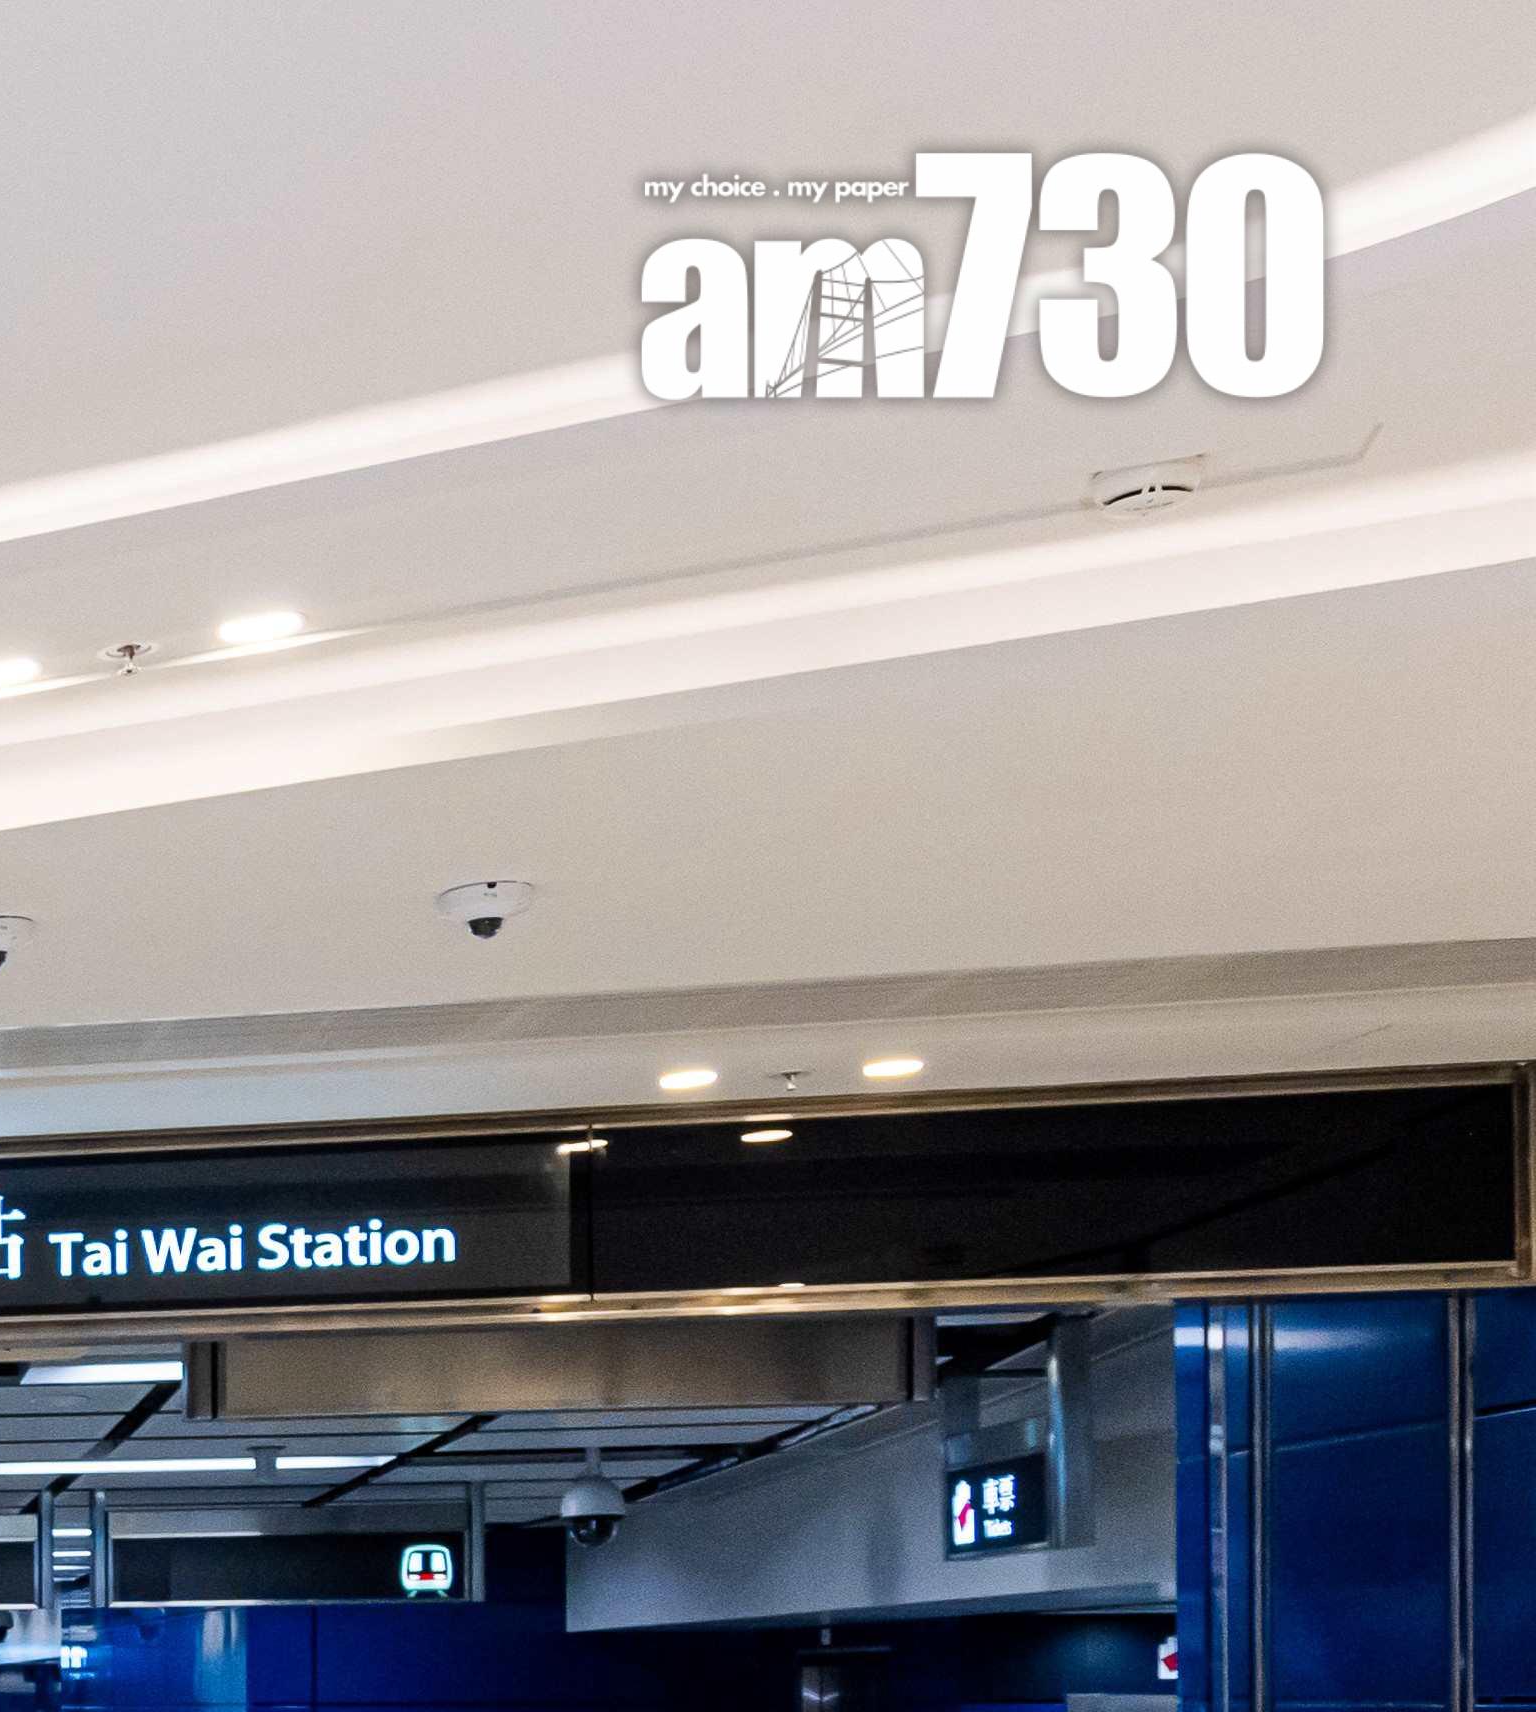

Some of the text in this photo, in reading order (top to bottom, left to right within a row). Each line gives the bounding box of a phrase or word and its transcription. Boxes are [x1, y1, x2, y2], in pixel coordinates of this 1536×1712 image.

[48, 1229, 128, 1277] Tai
[141, 1224, 243, 1274] Wai
[257, 1218, 457, 1271] Station
